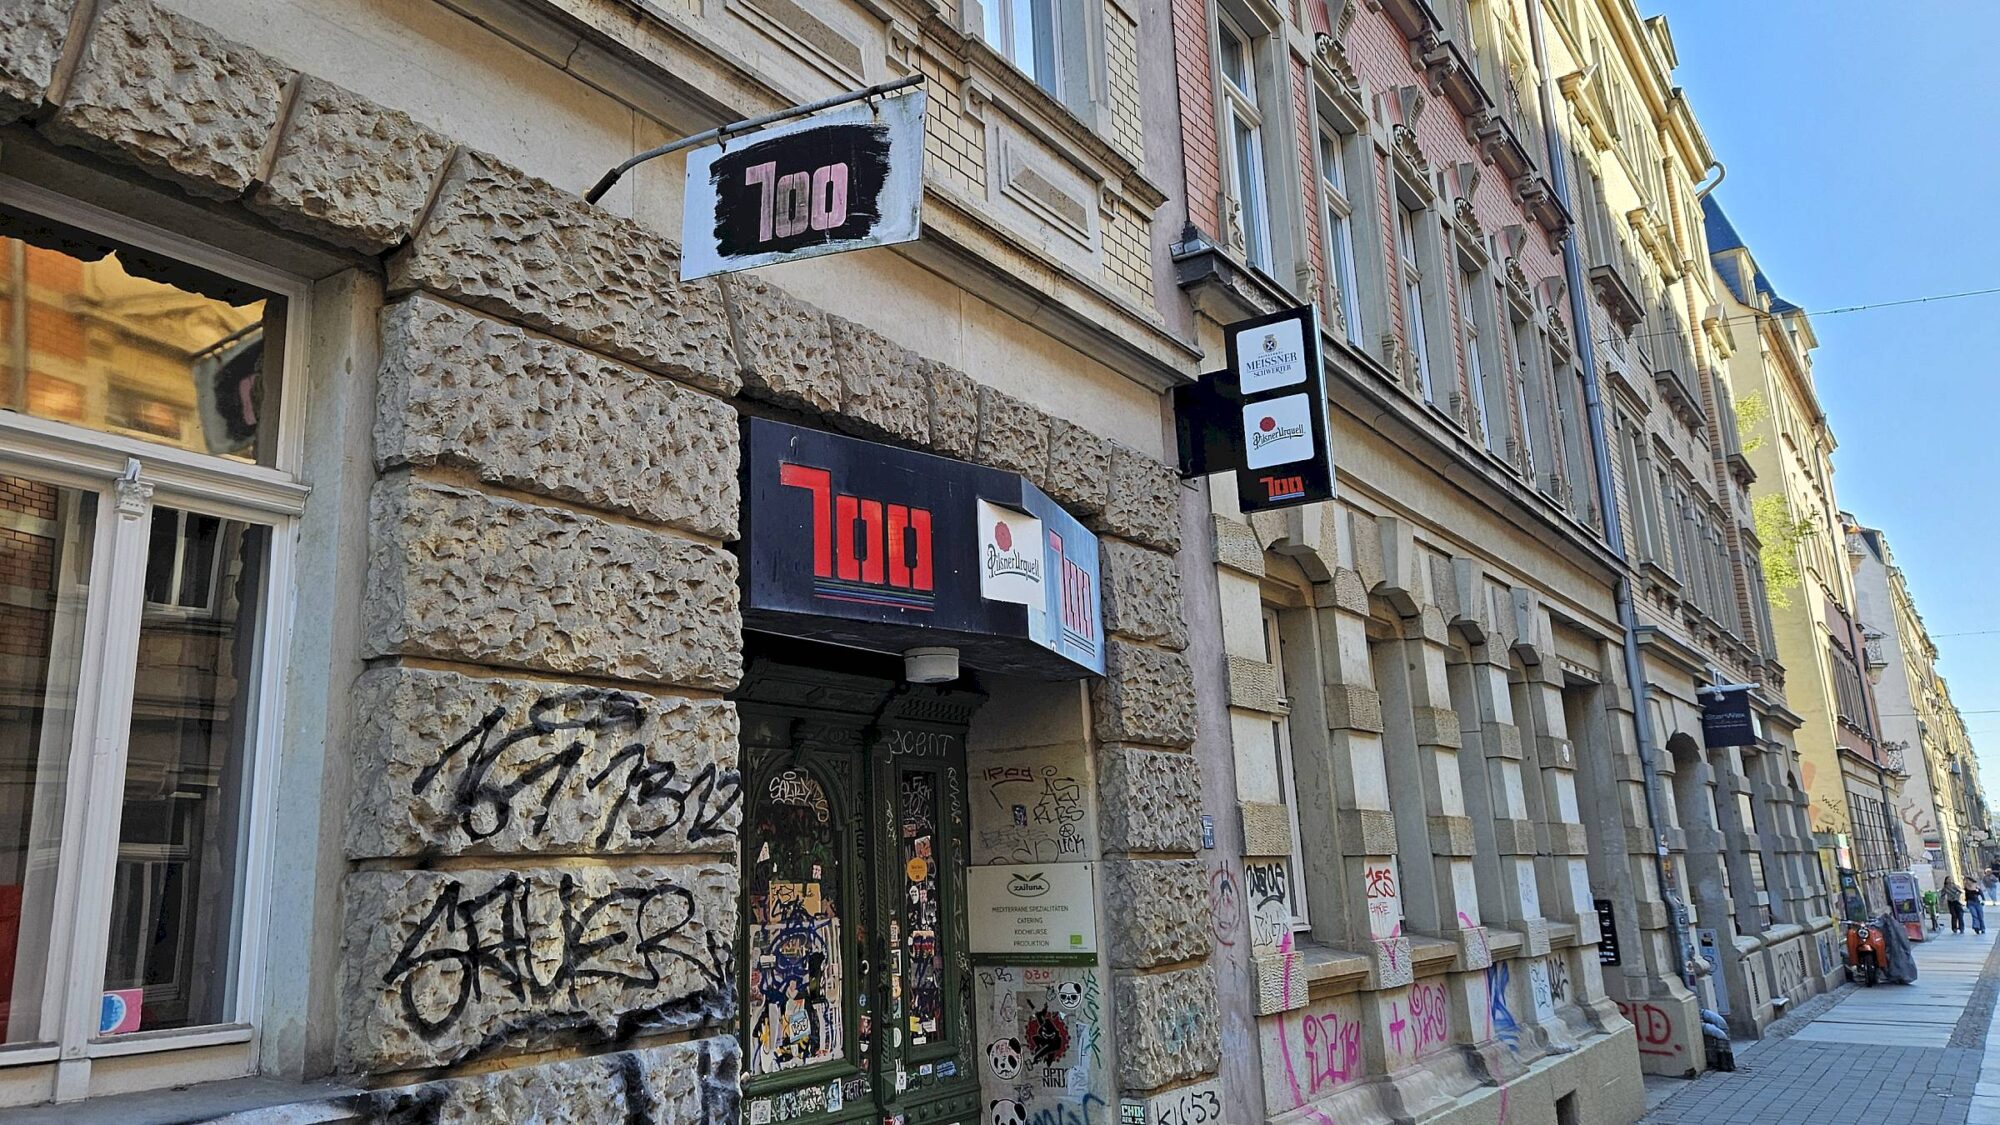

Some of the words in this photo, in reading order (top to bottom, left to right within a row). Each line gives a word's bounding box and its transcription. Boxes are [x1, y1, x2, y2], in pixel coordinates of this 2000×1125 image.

[1246, 352, 1297, 371] MEISSNER
[1253, 364, 1292, 378] SCHWERTER
[1252, 428, 1278, 451] Pilsner
[1277, 422, 1304, 440] Urquell
[987, 544, 1014, 578] Pilsner
[1014, 549, 1040, 581] Urquell
[1844, 876, 1852, 886] P
[1028, 904, 1068, 912] SPEZIALITÄTEN
[1042, 1068, 1069, 1078] OPTI
[1042, 1078, 1068, 1088] NINJ
